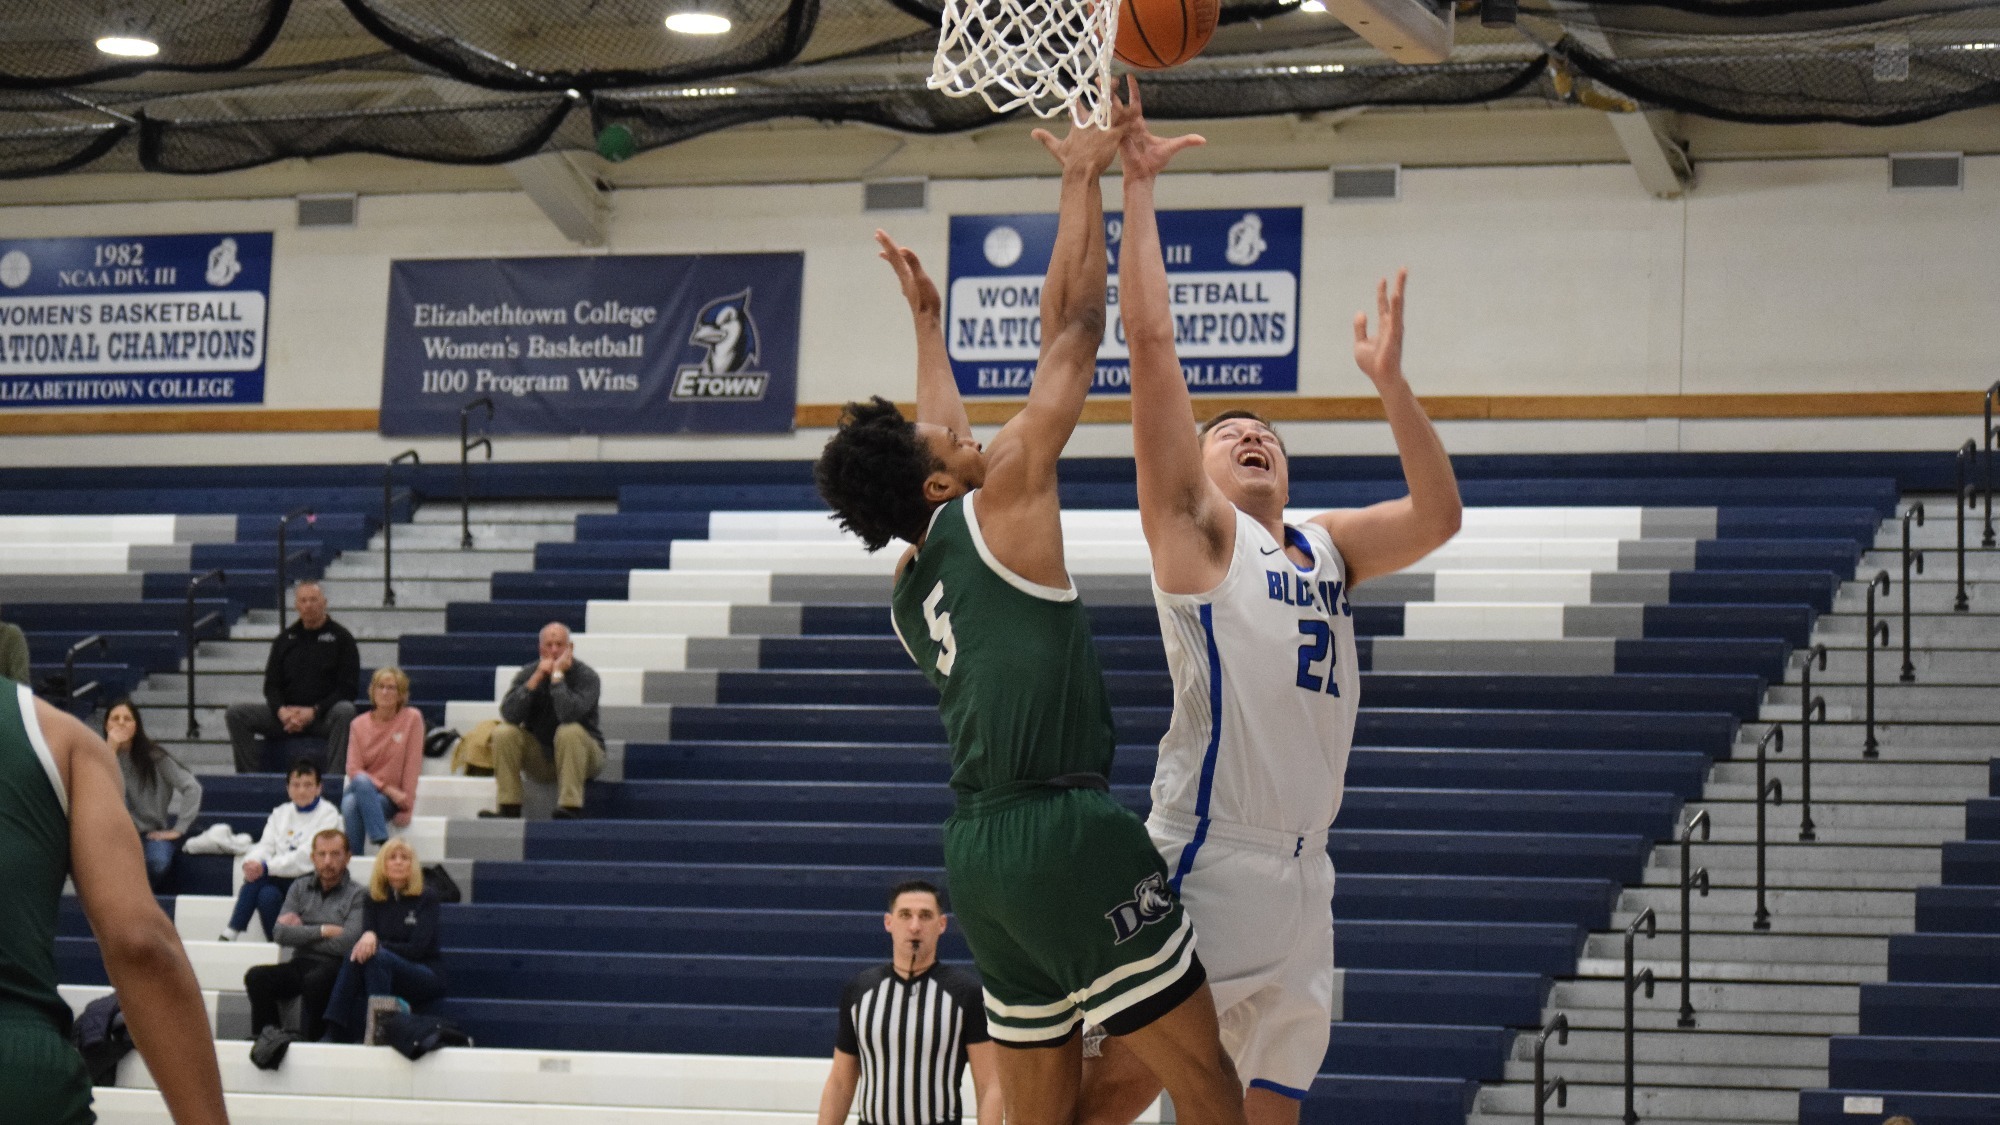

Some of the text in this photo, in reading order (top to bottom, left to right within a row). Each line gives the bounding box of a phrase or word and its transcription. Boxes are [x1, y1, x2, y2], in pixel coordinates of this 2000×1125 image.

[95, 244, 144, 267] 1982
[58, 268, 176, 287] NCAA DIV. III
[100, 302, 242, 323] BASKETBALL
[413, 301, 658, 328] Elizabethtown College
[0, 330, 256, 363] TIONAL CHAMPIONS
[422, 335, 643, 360] Women's Basketball
[421, 368, 639, 396] 1100 Program Wins
[676, 370, 762, 396] ETOWN
[1183, 363, 1263, 386] OLLEGE
[0, 377, 235, 400] LIZABETHTOWN COLLEGE
[922, 579, 957, 677] 5
